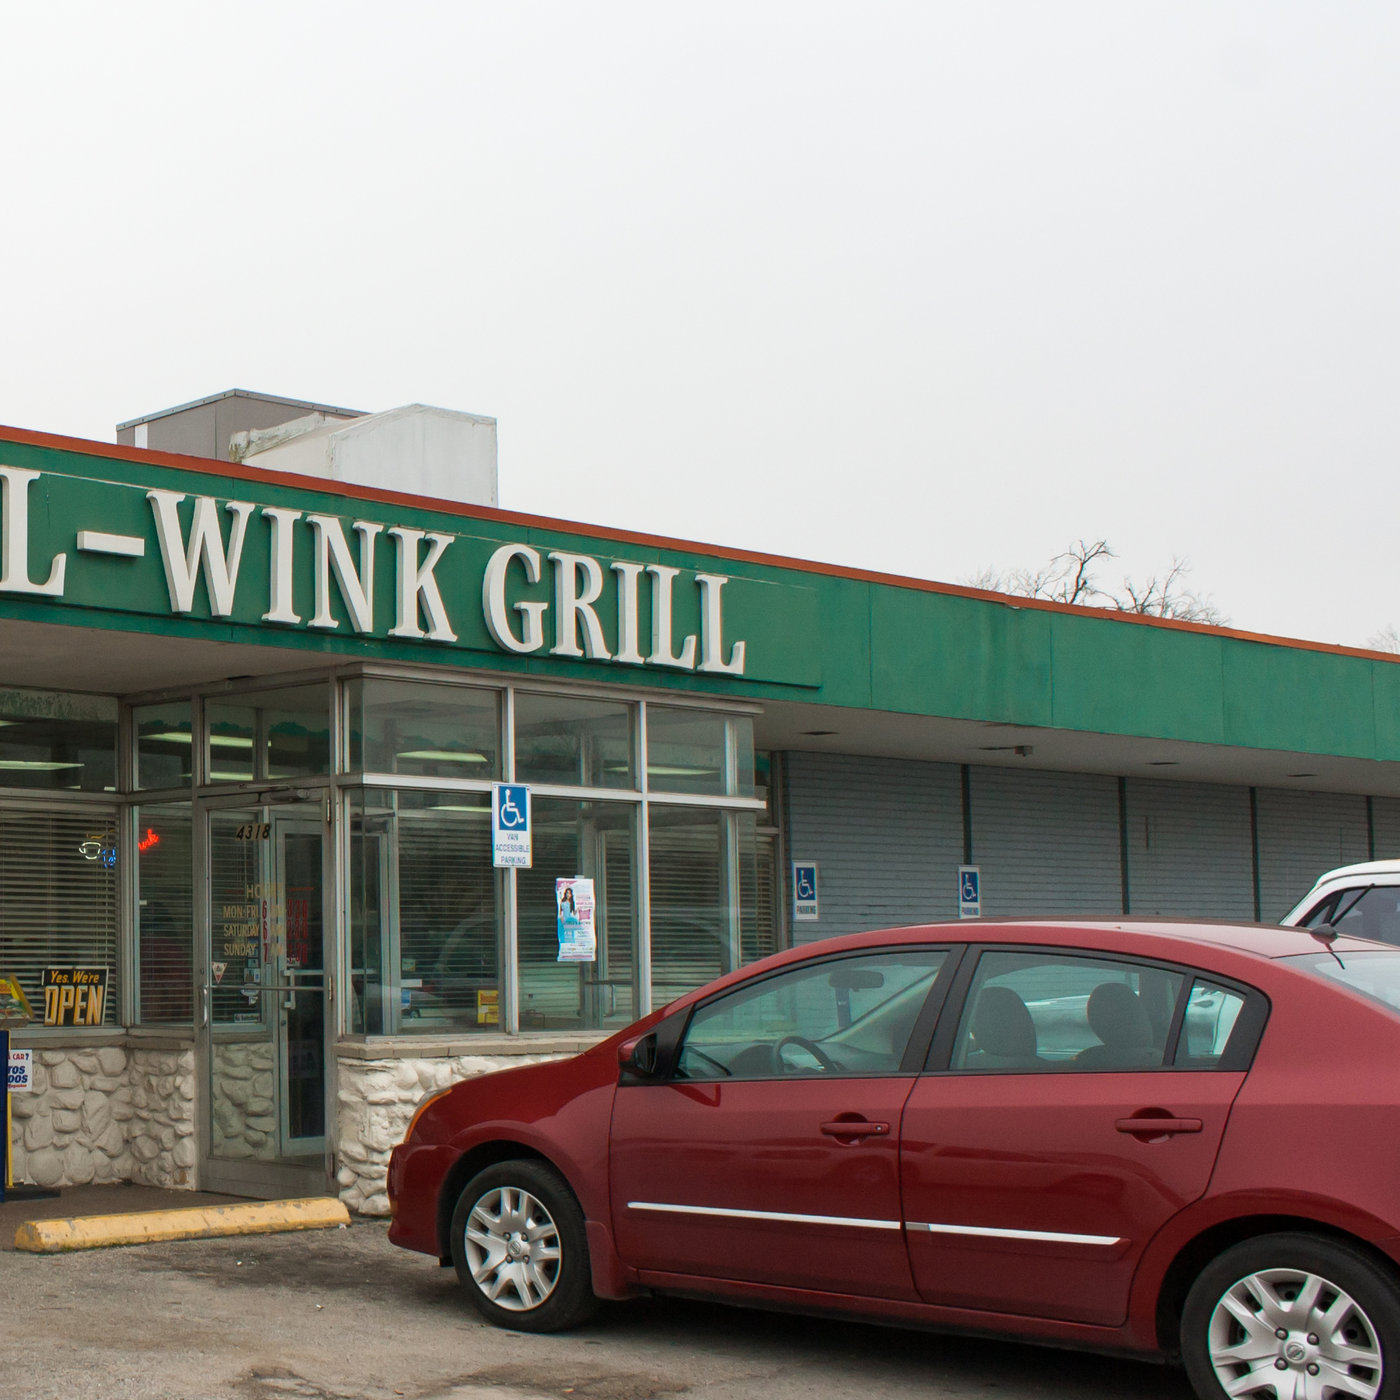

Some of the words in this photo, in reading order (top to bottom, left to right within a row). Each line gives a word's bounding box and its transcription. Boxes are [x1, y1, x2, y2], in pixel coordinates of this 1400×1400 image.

[482, 543, 746, 676] GRILL
[236, 823, 271, 841] 4318
[506, 832, 519, 841] VAN
[495, 843, 530, 853] ACCESSIBLE
[500, 855, 527, 865] PARKING
[223, 923, 260, 937] SATURDAY
[224, 943, 257, 957] SUNDAY
[73, 970, 100, 984] We're
[44, 985, 104, 1027] OPEN
